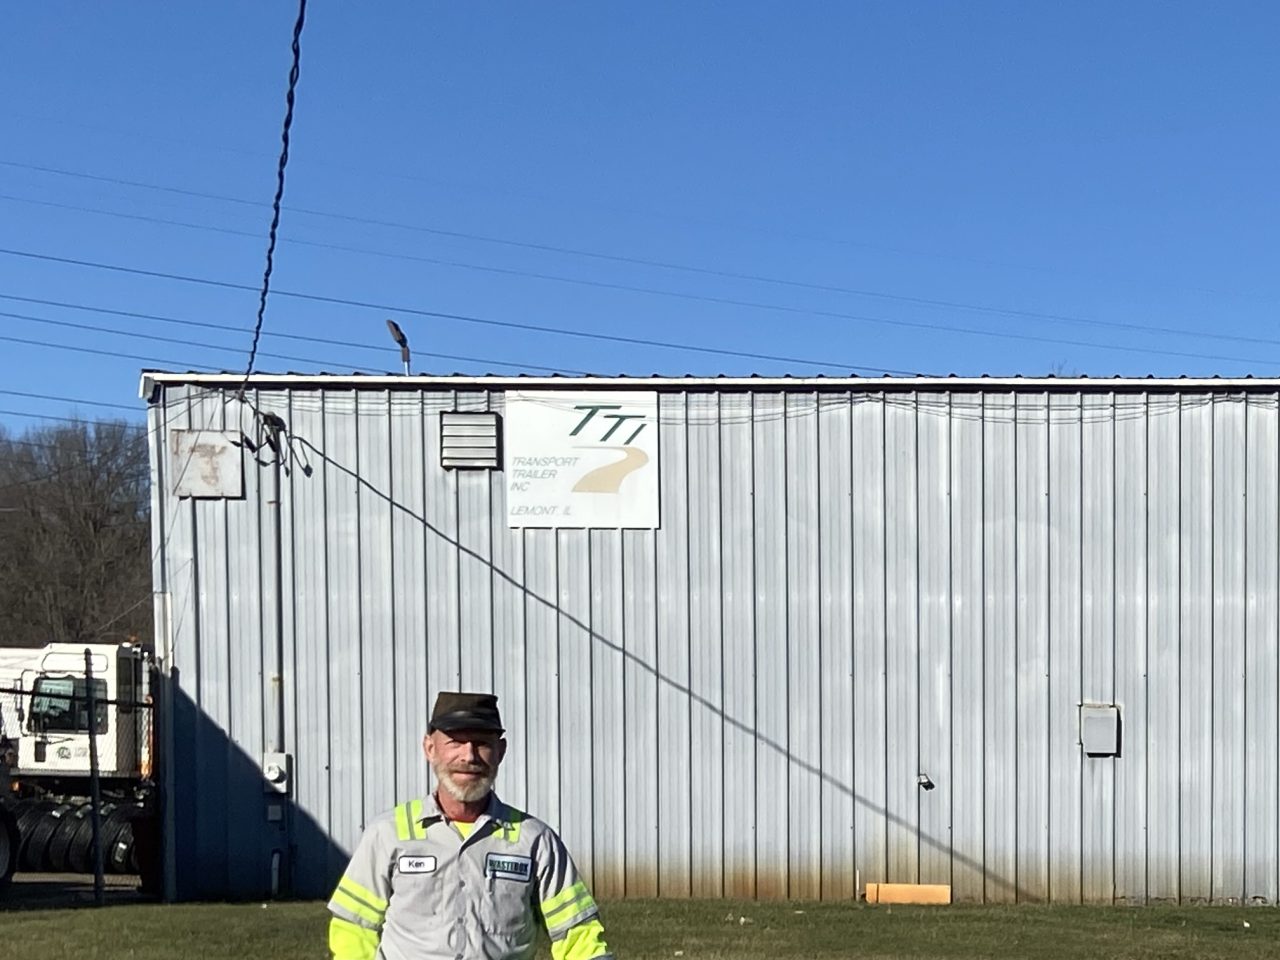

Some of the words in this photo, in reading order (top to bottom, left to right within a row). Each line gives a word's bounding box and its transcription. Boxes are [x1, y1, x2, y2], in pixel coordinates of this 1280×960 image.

[510, 456, 580, 467] TRANSPORT
[511, 469, 558, 479] TRAILER
[408, 858, 425, 868] Ken
